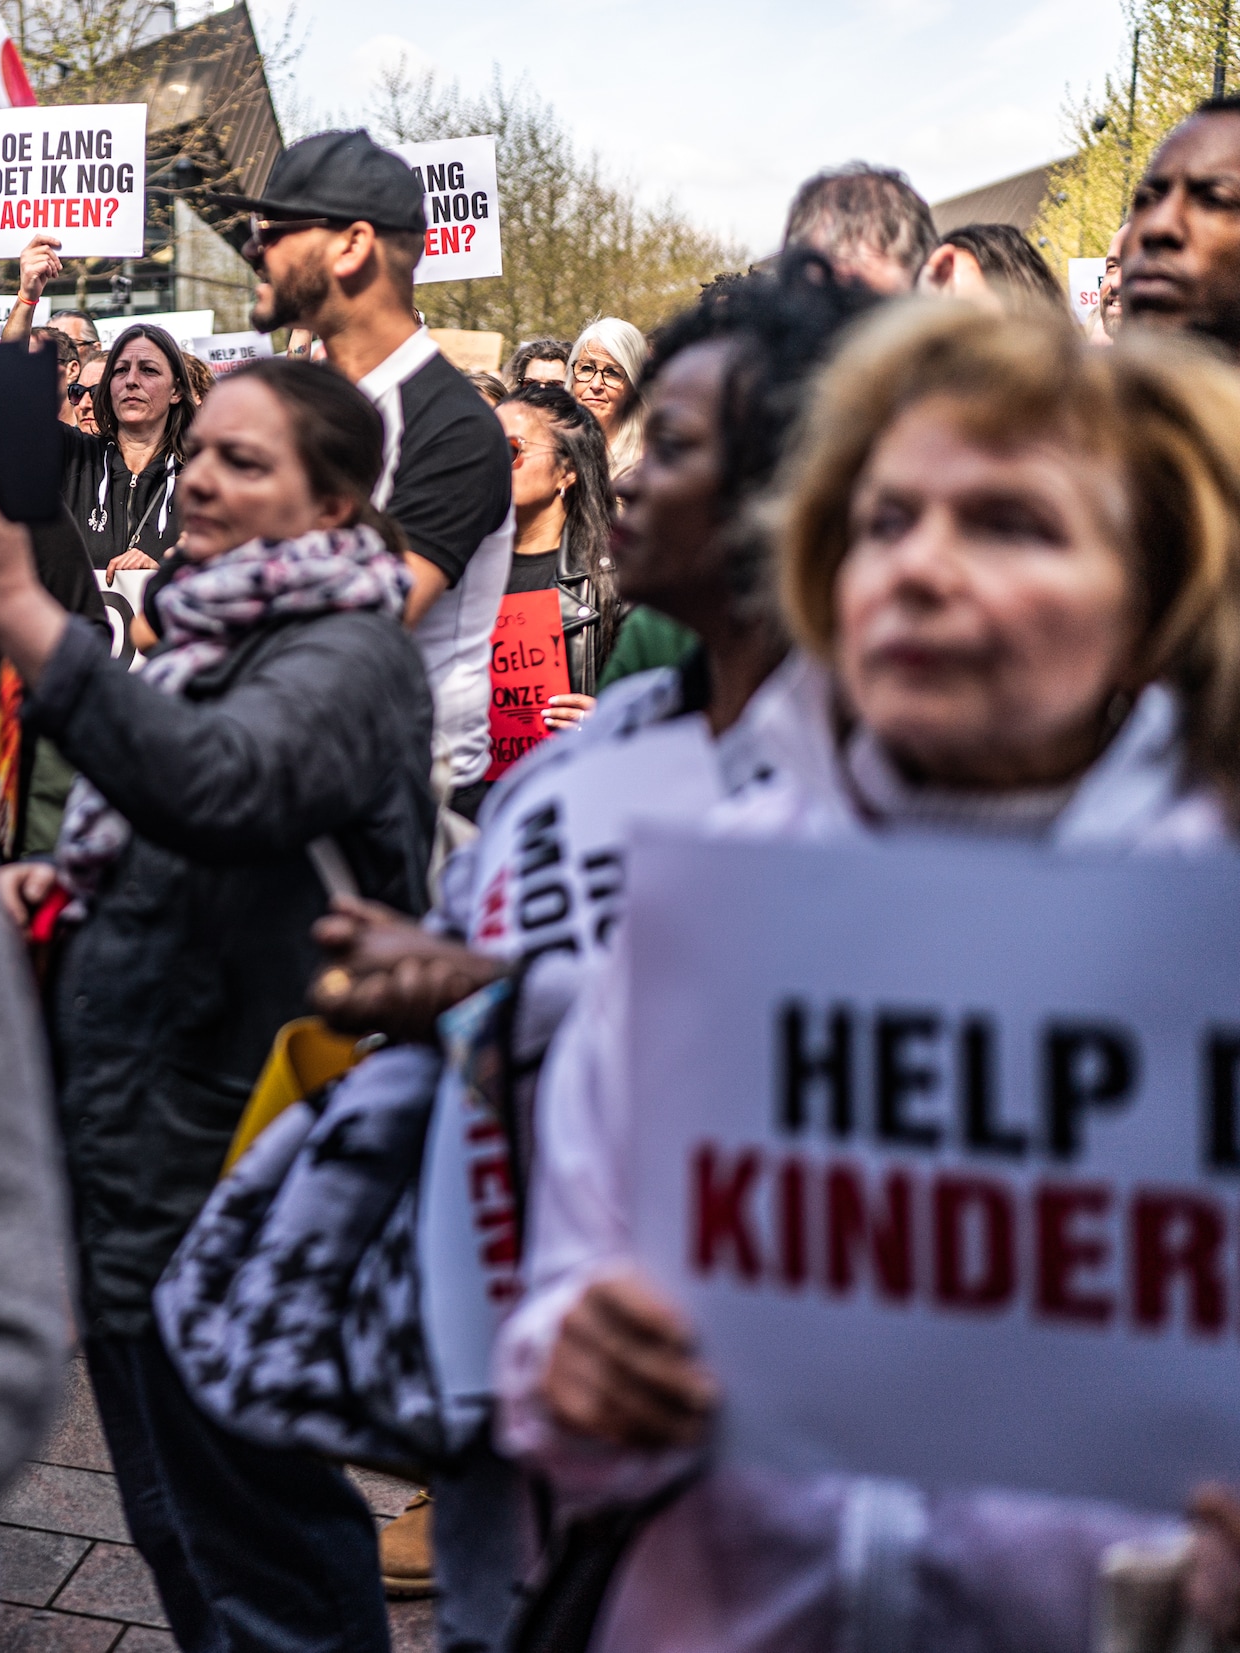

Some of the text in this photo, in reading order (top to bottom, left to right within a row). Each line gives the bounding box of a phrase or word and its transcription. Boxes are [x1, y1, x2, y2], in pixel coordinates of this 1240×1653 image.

[42, 129, 113, 160] LANG
[41, 165, 67, 194] IK
[77, 162, 134, 194] NOG
[411, 162, 465, 193] ANG
[431, 191, 488, 224] NOG
[424, 224, 476, 256] EN?
[1080, 291, 1098, 305] SC
[208, 346, 257, 361] HELP DE
[492, 685, 545, 708] ONZE
[778, 996, 1140, 1164] HELP
[691, 1140, 1240, 1342] KINDER
